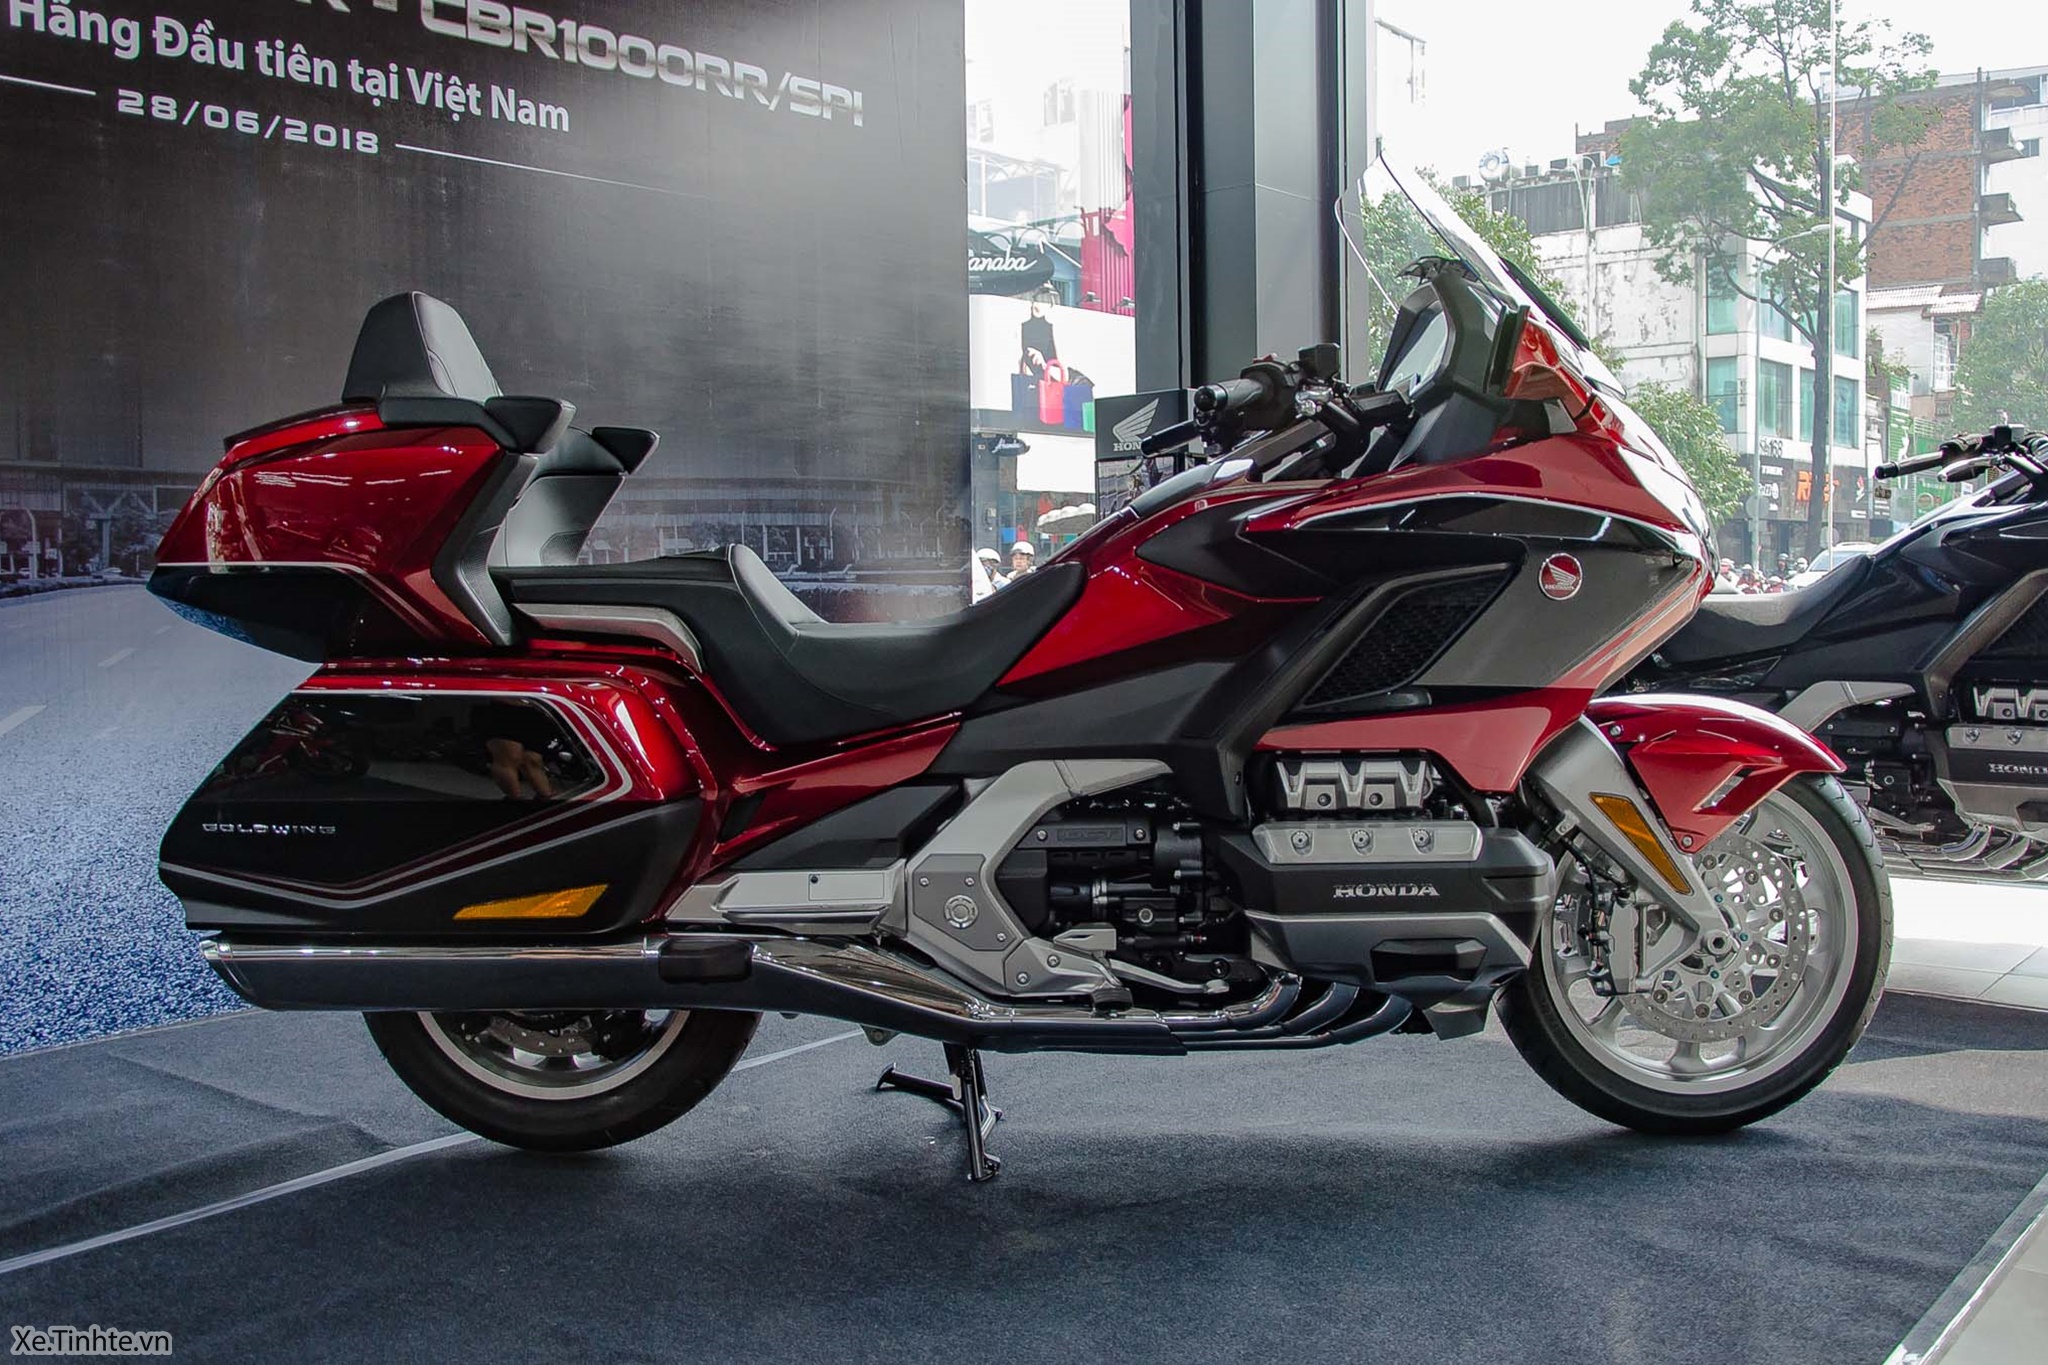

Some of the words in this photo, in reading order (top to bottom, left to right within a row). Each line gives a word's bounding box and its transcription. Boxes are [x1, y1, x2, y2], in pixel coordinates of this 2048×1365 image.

[152, 15, 244, 70] Đầu
[255, 39, 337, 88] tiên
[348, 59, 398, 107] tại
[406, 67, 481, 122] Việt
[491, 84, 569, 132] Nam
[117, 88, 379, 153] 28/06/2018
[1333, 883, 1440, 898] HONDA
